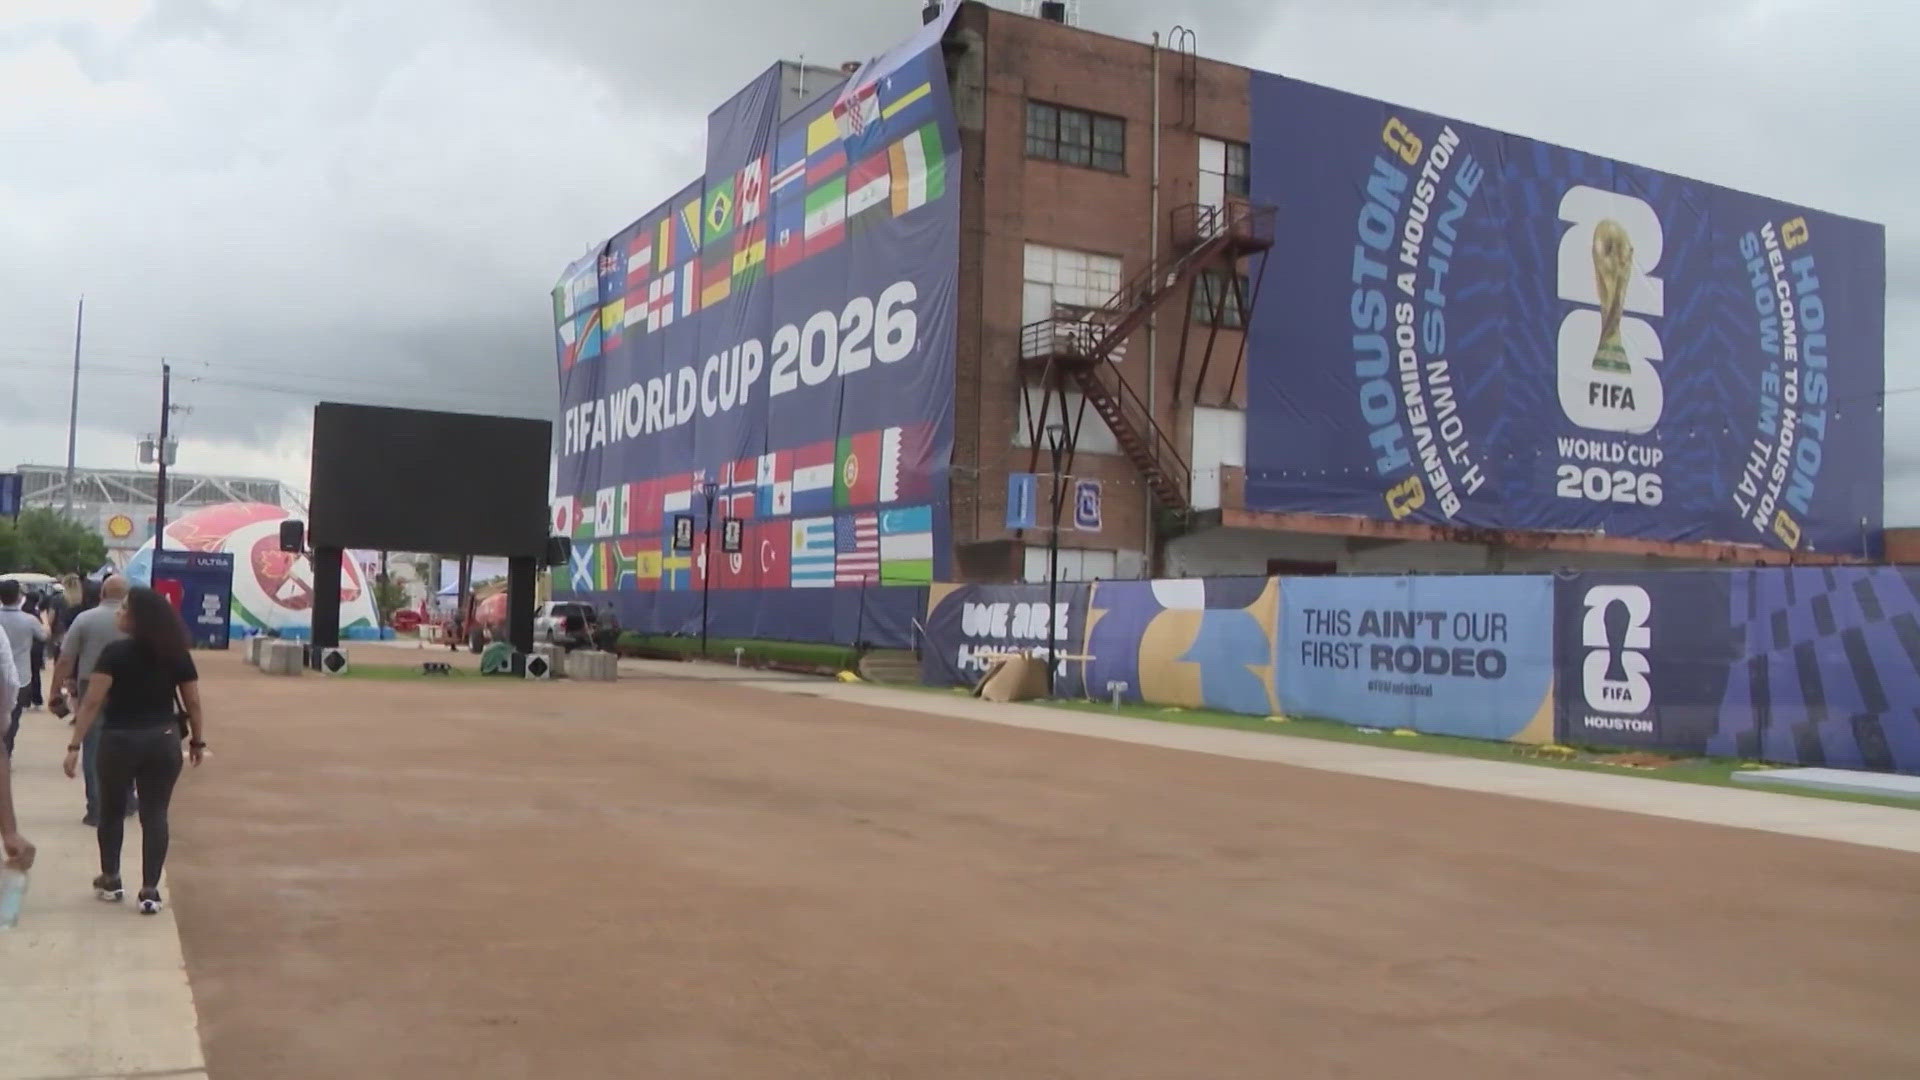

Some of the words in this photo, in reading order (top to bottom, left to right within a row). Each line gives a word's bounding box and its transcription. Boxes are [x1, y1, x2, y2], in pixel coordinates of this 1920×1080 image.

[1400, 124, 1460, 267] HOUSTON
[1397, 272, 1417, 297] A
[1423, 153, 1484, 355] SHINE
[1351, 155, 1411, 476] HOUSTON
[1739, 231, 1780, 354] SHOW
[1761, 221, 1798, 361] WELCOME
[565, 399, 606, 457] FIFA
[610, 366, 697, 443] WORLD
[701, 338, 764, 417] CUP
[769, 281, 917, 397] 2026
[1588, 381, 1635, 411] FIFA
[1784, 368, 1798, 404] TO
[1785, 254, 1829, 516] HOUSTON
[1395, 302, 1462, 519] BIENVENIDOS
[1426, 359, 1486, 496] H-TOWN
[1557, 436, 1624, 463] WORLD
[1627, 444, 1663, 468] CUP
[1733, 438, 1773, 518] THAT
[1752, 408, 1797, 533] HOUSTON
[1556, 464, 1663, 506] 2026
[197, 558, 228, 567] ULTRA
[961, 602, 1010, 638] WE
[1012, 602, 1070, 640] ARE
[1303, 609, 1351, 636] THIS
[1357, 610, 1447, 640] AIN'T
[1453, 612, 1507, 643] OUR
[1301, 641, 1363, 670] FIRST
[1370, 644, 1507, 679] RODEO
[1584, 715, 1653, 733] HOUSTON
[1602, 686, 1633, 701] FIFA
